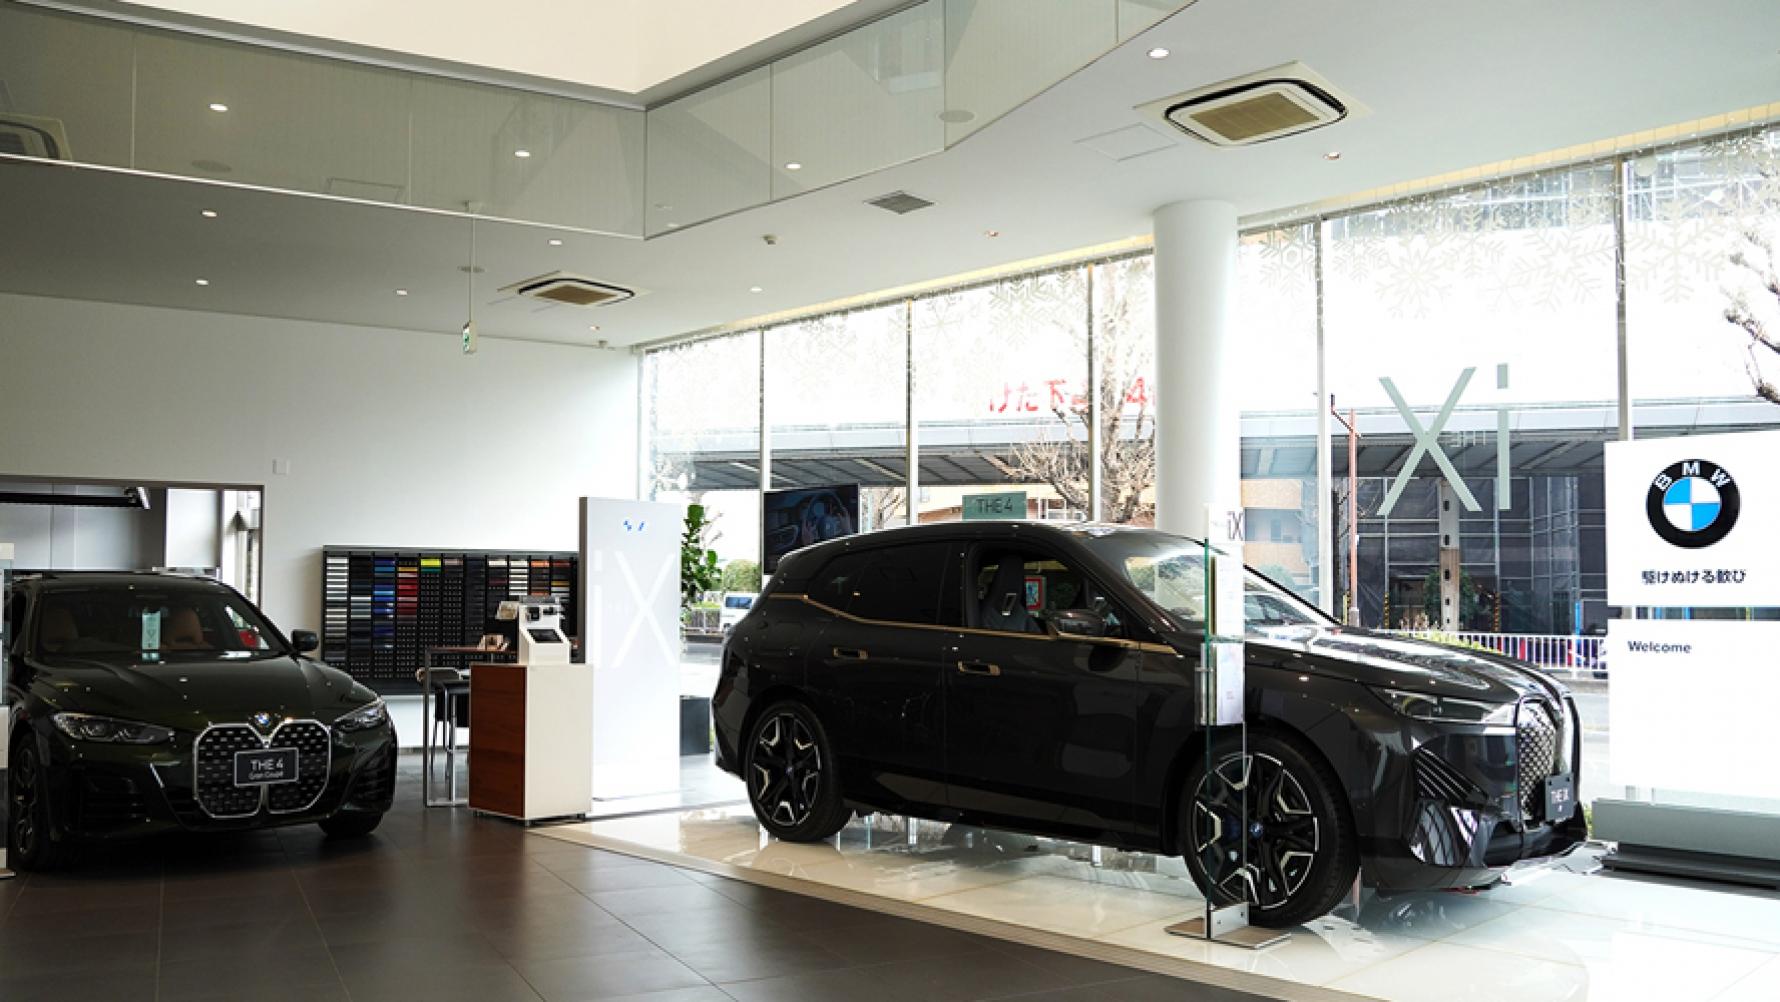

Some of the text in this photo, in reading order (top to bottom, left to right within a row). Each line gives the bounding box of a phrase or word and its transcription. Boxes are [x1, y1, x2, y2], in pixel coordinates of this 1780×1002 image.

[1654, 460, 1731, 491] BMW
[976, 497, 1013, 513] THE 4
[1641, 569, 1747, 584] 駆けぬける歓び
[1627, 640, 1692, 654] Welcome
[250, 757, 284, 771] THE 4
